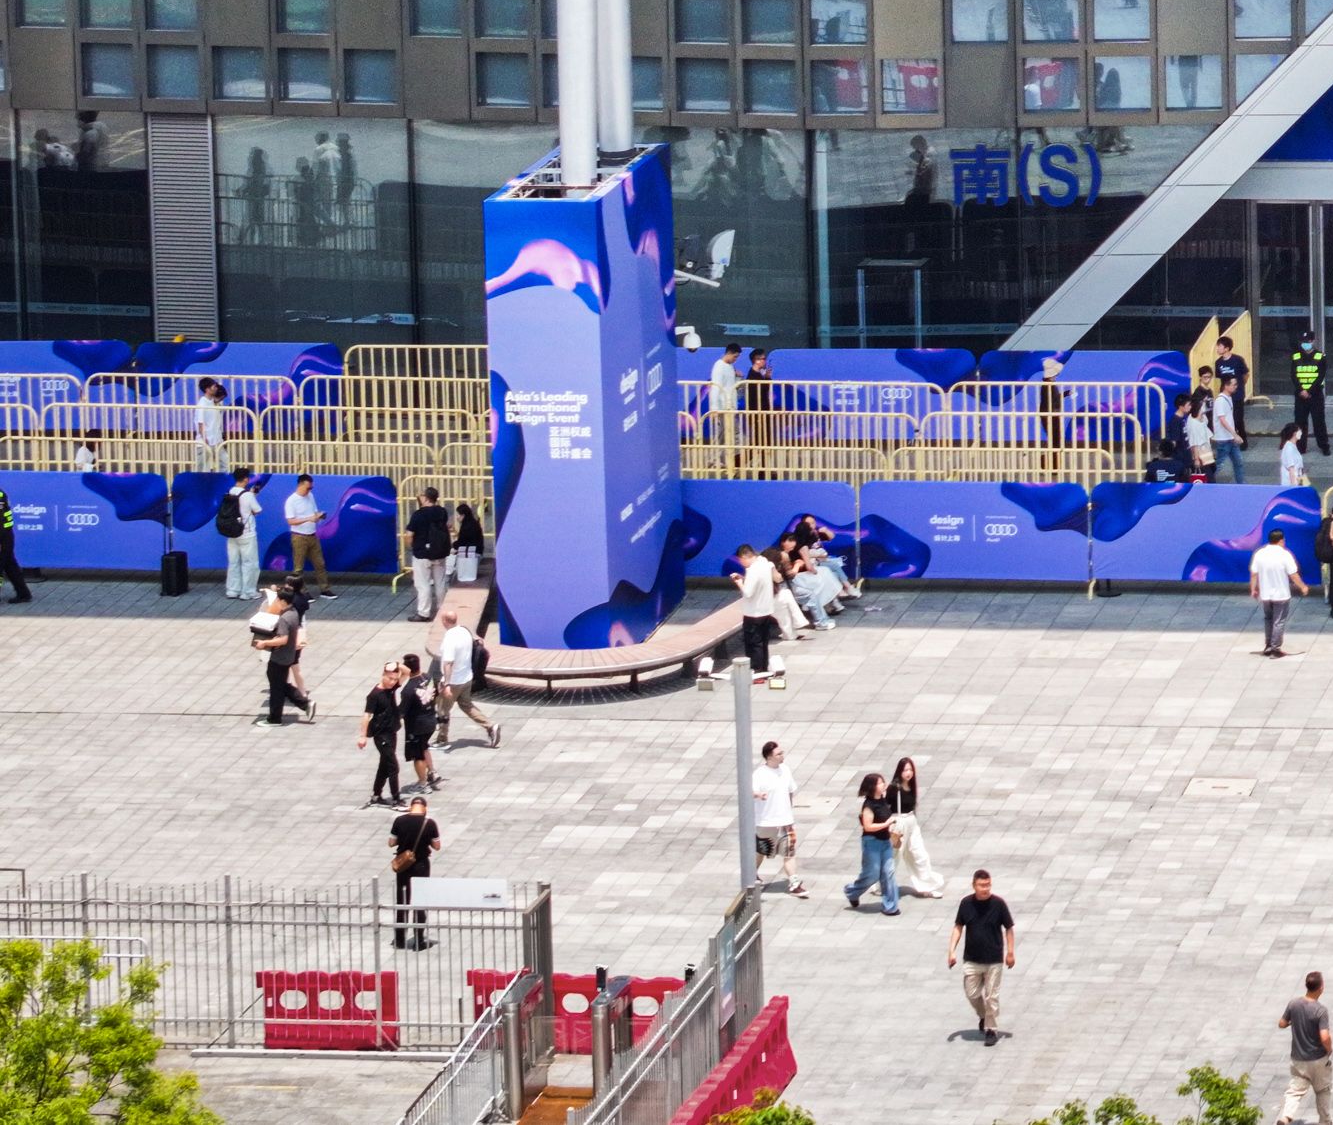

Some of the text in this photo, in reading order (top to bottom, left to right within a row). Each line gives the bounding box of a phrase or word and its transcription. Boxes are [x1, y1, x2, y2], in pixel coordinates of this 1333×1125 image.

[540, 390, 588, 405] Leading
[505, 401, 581, 412] International
[505, 412, 580, 426] Design Event
[13, 504, 47, 515] design
[929, 515, 965, 526] design
